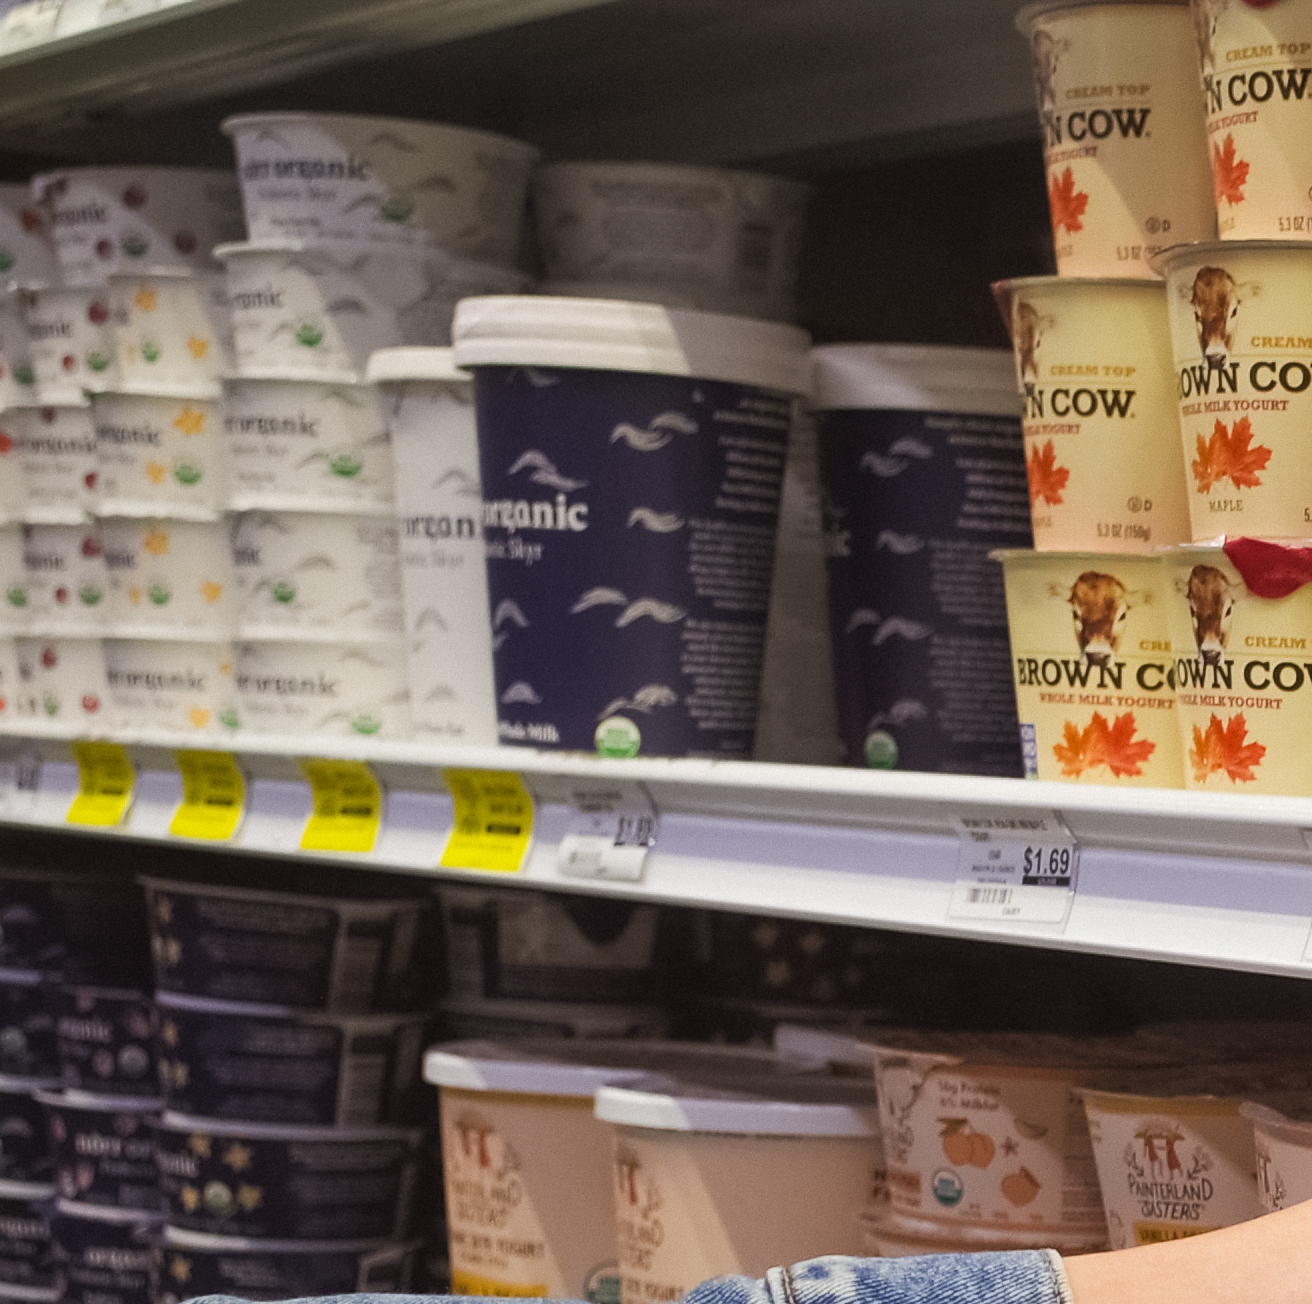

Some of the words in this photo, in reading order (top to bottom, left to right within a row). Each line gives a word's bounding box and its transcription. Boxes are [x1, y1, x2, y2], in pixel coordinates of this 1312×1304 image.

[1250, 336, 1312, 350] CREAM
[1018, 660, 1124, 690] BROWN
[1023, 845, 1070, 878] $1.69
